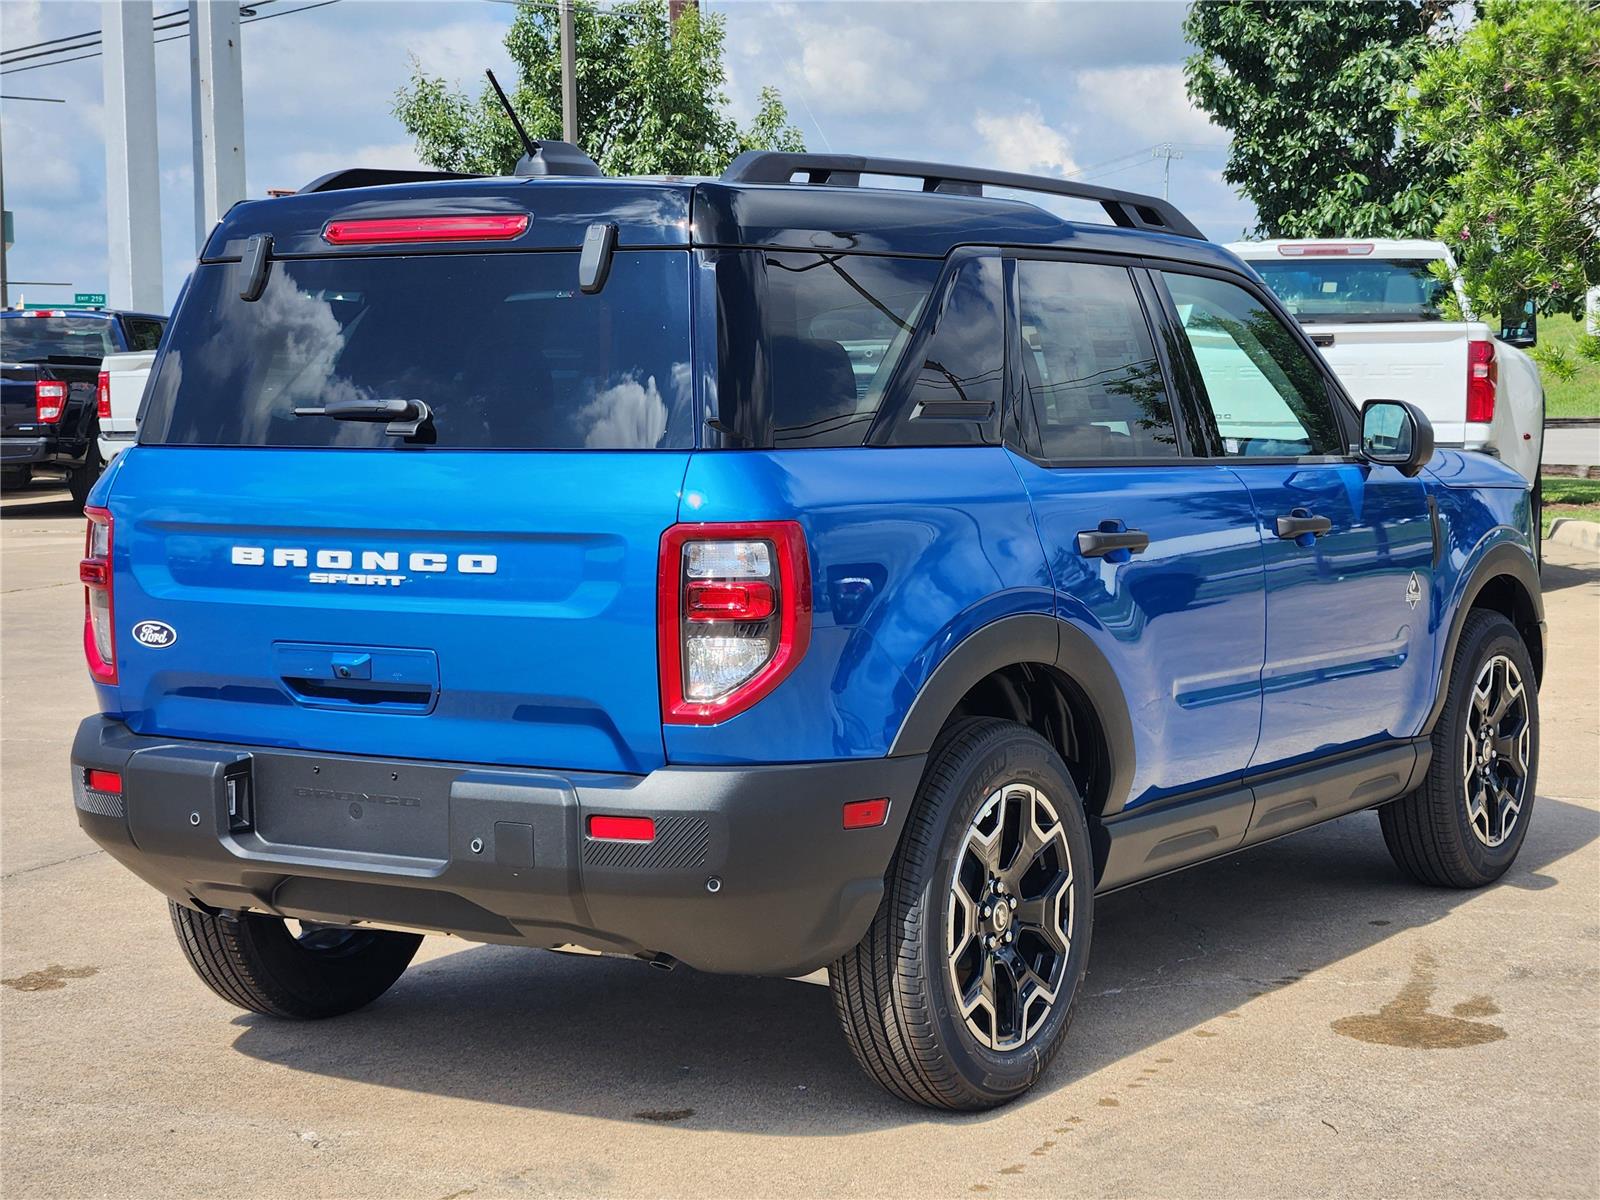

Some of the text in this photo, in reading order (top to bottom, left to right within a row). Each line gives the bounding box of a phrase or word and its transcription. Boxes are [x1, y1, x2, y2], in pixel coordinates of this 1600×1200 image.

[231, 546, 498, 574] BRONCO
[309, 572, 407, 586] SPORT
[140, 624, 168, 643] Ford
[960, 752, 1007, 818] MICHELIN
[295, 786, 421, 807] BRONCO
